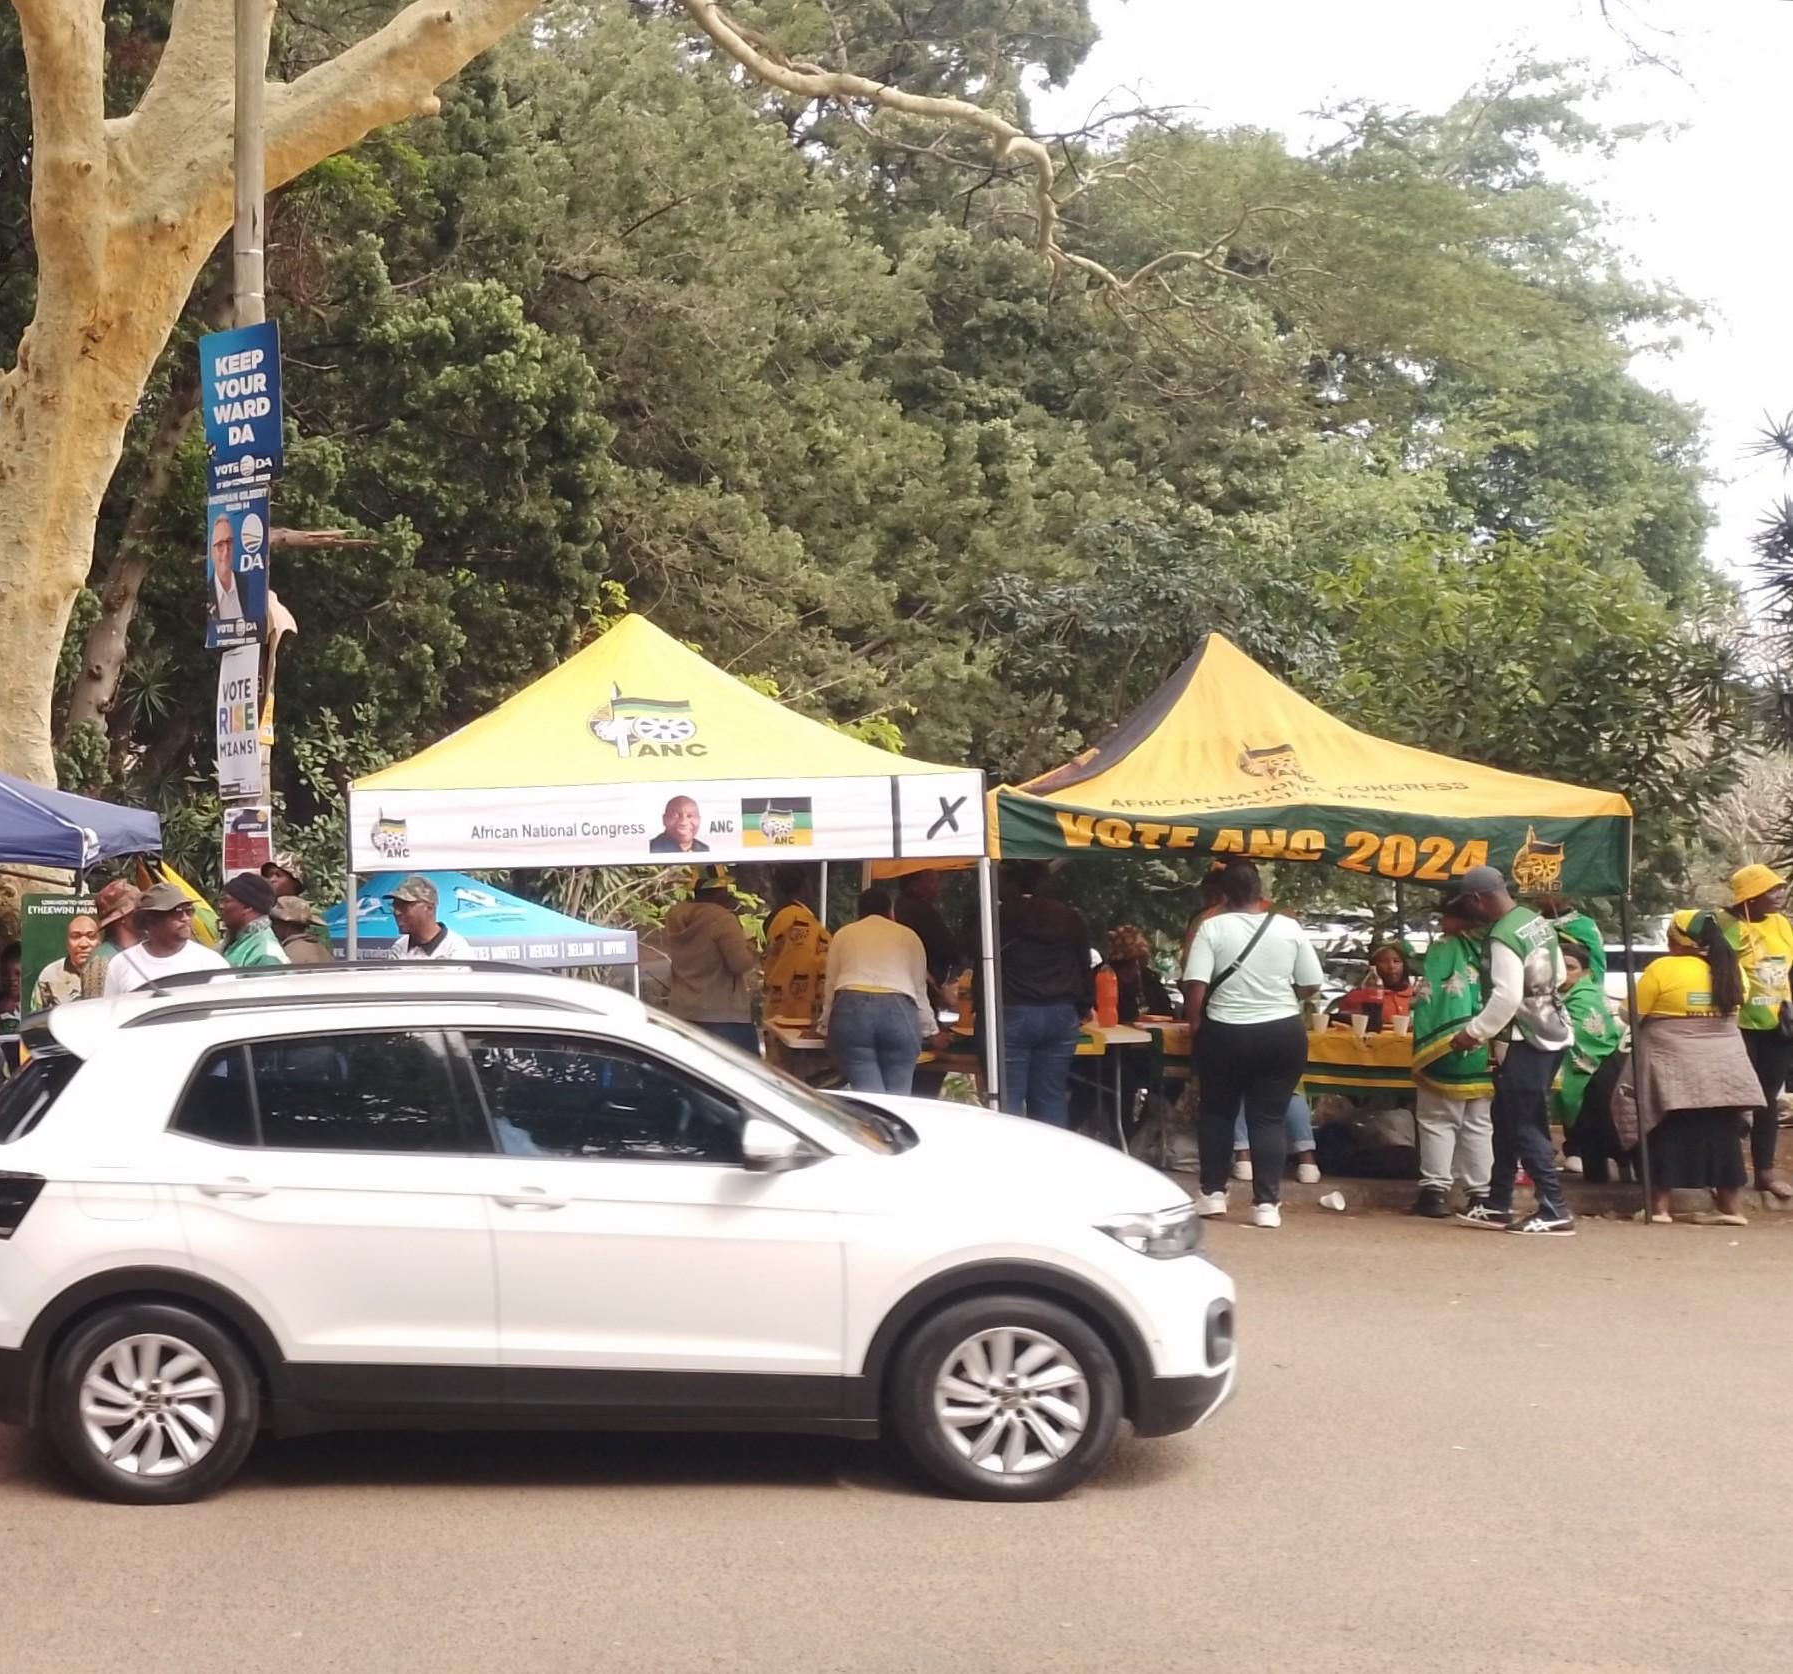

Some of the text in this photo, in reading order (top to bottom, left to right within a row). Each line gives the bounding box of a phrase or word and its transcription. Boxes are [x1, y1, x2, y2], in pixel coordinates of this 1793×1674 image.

[214, 348, 265, 377] KEEP
[214, 372, 267, 400] YOUR
[213, 396, 271, 425] WARD
[228, 423, 255, 446] DA
[214, 457, 273, 477] VOTE DA
[239, 553, 265, 572] DA
[215, 622, 258, 634] VOTE DA
[223, 678, 252, 702] VOTE
[220, 739, 257, 758] MZANSI
[638, 743, 708, 757] ANC
[1111, 798, 1211, 808] AFRICAN
[1336, 782, 1469, 793] CONGRESS
[471, 825, 518, 840] African
[522, 822, 578, 838] National
[581, 820, 646, 841] Congress
[709, 820, 734, 834] ANC
[774, 836, 795, 845] ANC
[386, 848, 410, 858] ANC
[1056, 812, 1489, 881] VOTE ANC 2024
[27, 905, 75, 915] ETHEKWINI
